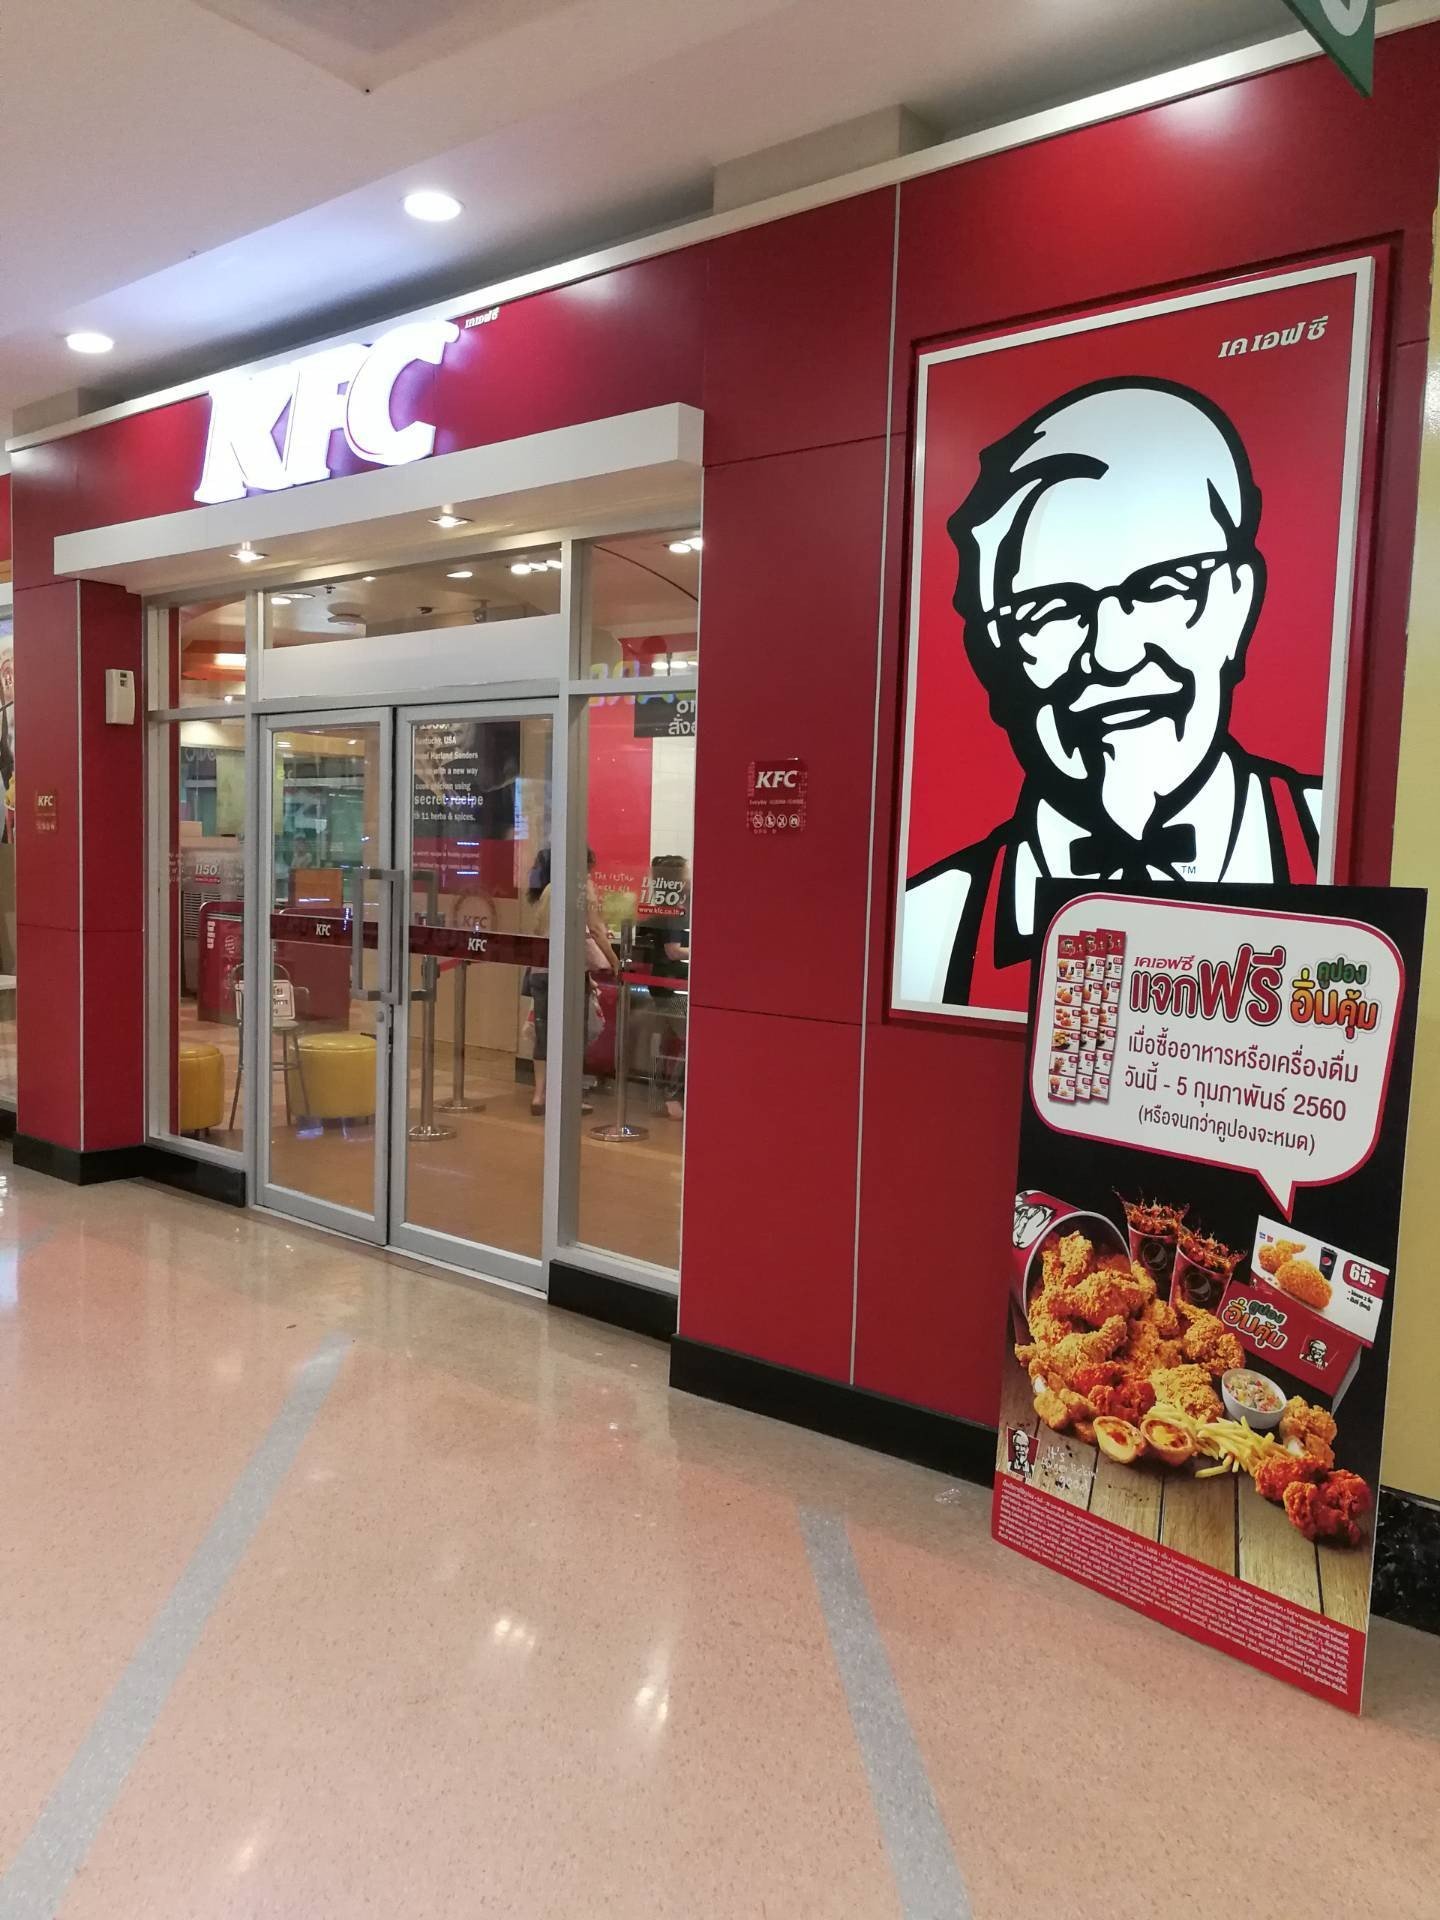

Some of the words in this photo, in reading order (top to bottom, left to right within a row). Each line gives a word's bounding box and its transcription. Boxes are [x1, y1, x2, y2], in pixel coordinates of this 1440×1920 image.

[193, 318, 459, 504] KFC
[755, 770, 799, 789] KFC
[38, 795, 54, 807] KFC
[641, 876, 687, 893] Delivery
[316, 923, 331, 937] KFC
[467, 937, 488, 952] KFC
[1133, 953, 1197, 972] เคเอฟซี
[1316, 956, 1368, 989] คูปอง
[1130, 943, 1286, 1026] แจกฟรี
[1290, 967, 1379, 1040] อิ่มคุ้ม
[1128, 1024, 1359, 1083] เมื่อซื้ออาหารหรือเครื่องดื่ม
[1124, 1061, 1160, 1092] วันนี้
[1176, 1076, 1188, 1096] 5
[1193, 1080, 1288, 1112] กุมภาพันธ์
[1292, 1093, 1347, 1122] 2560
[1138, 1104, 1316, 1157] (หรือจนกว่าคูปองจะหมด)
